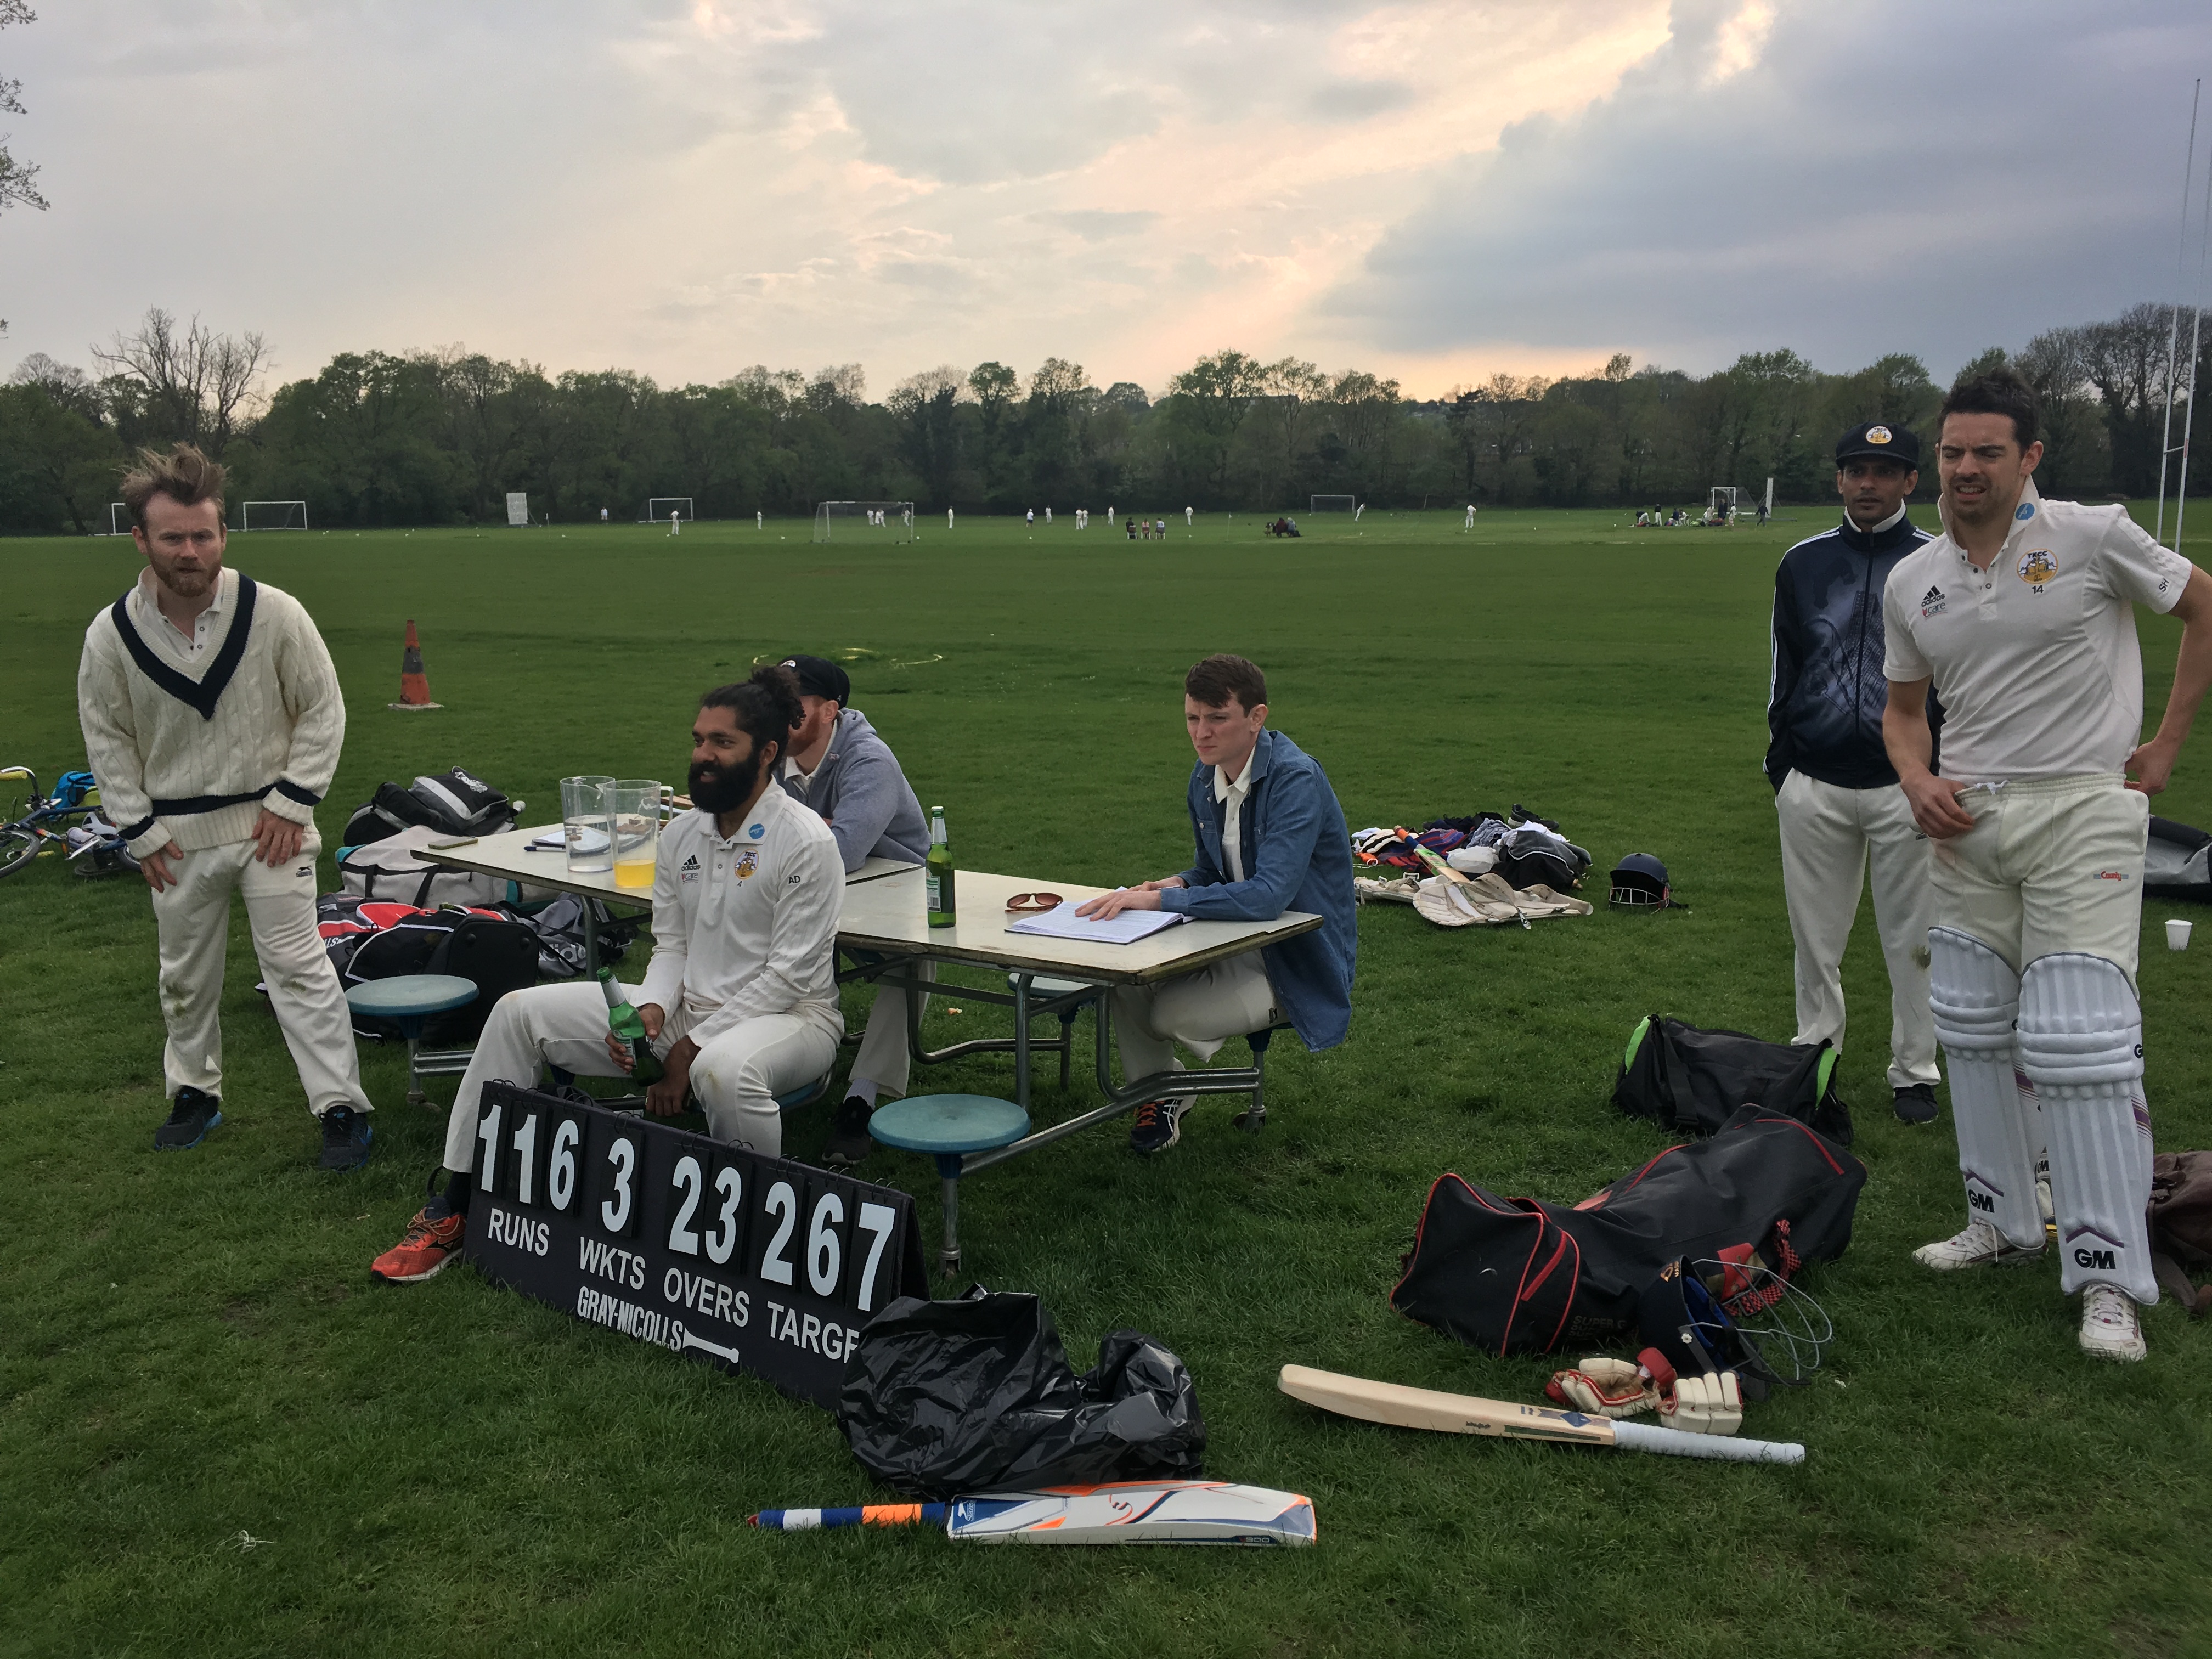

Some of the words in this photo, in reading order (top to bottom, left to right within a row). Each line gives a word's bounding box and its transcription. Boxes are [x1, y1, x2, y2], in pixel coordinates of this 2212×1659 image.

[2032, 585, 2044, 594] 14
[2158, 578, 2169, 592] SH
[1921, 593, 1945, 607] adidas
[788, 875, 801, 884] AD
[479, 1104, 579, 1210] 116
[602, 1138, 634, 1232] 3
[669, 1156, 741, 1264] 23
[761, 1181, 895, 1311] 267
[1968, 1189, 1995, 1213] GM
[2074, 1248, 2116, 1269] GM
[488, 1208, 549, 1256] RUNS
[580, 1236, 646, 1290] WKTS
[664, 1268, 750, 1327] OVERS
[767, 1301, 860, 1363] TARGE
[577, 1286, 683, 1352] GRAY-NICOLLS
